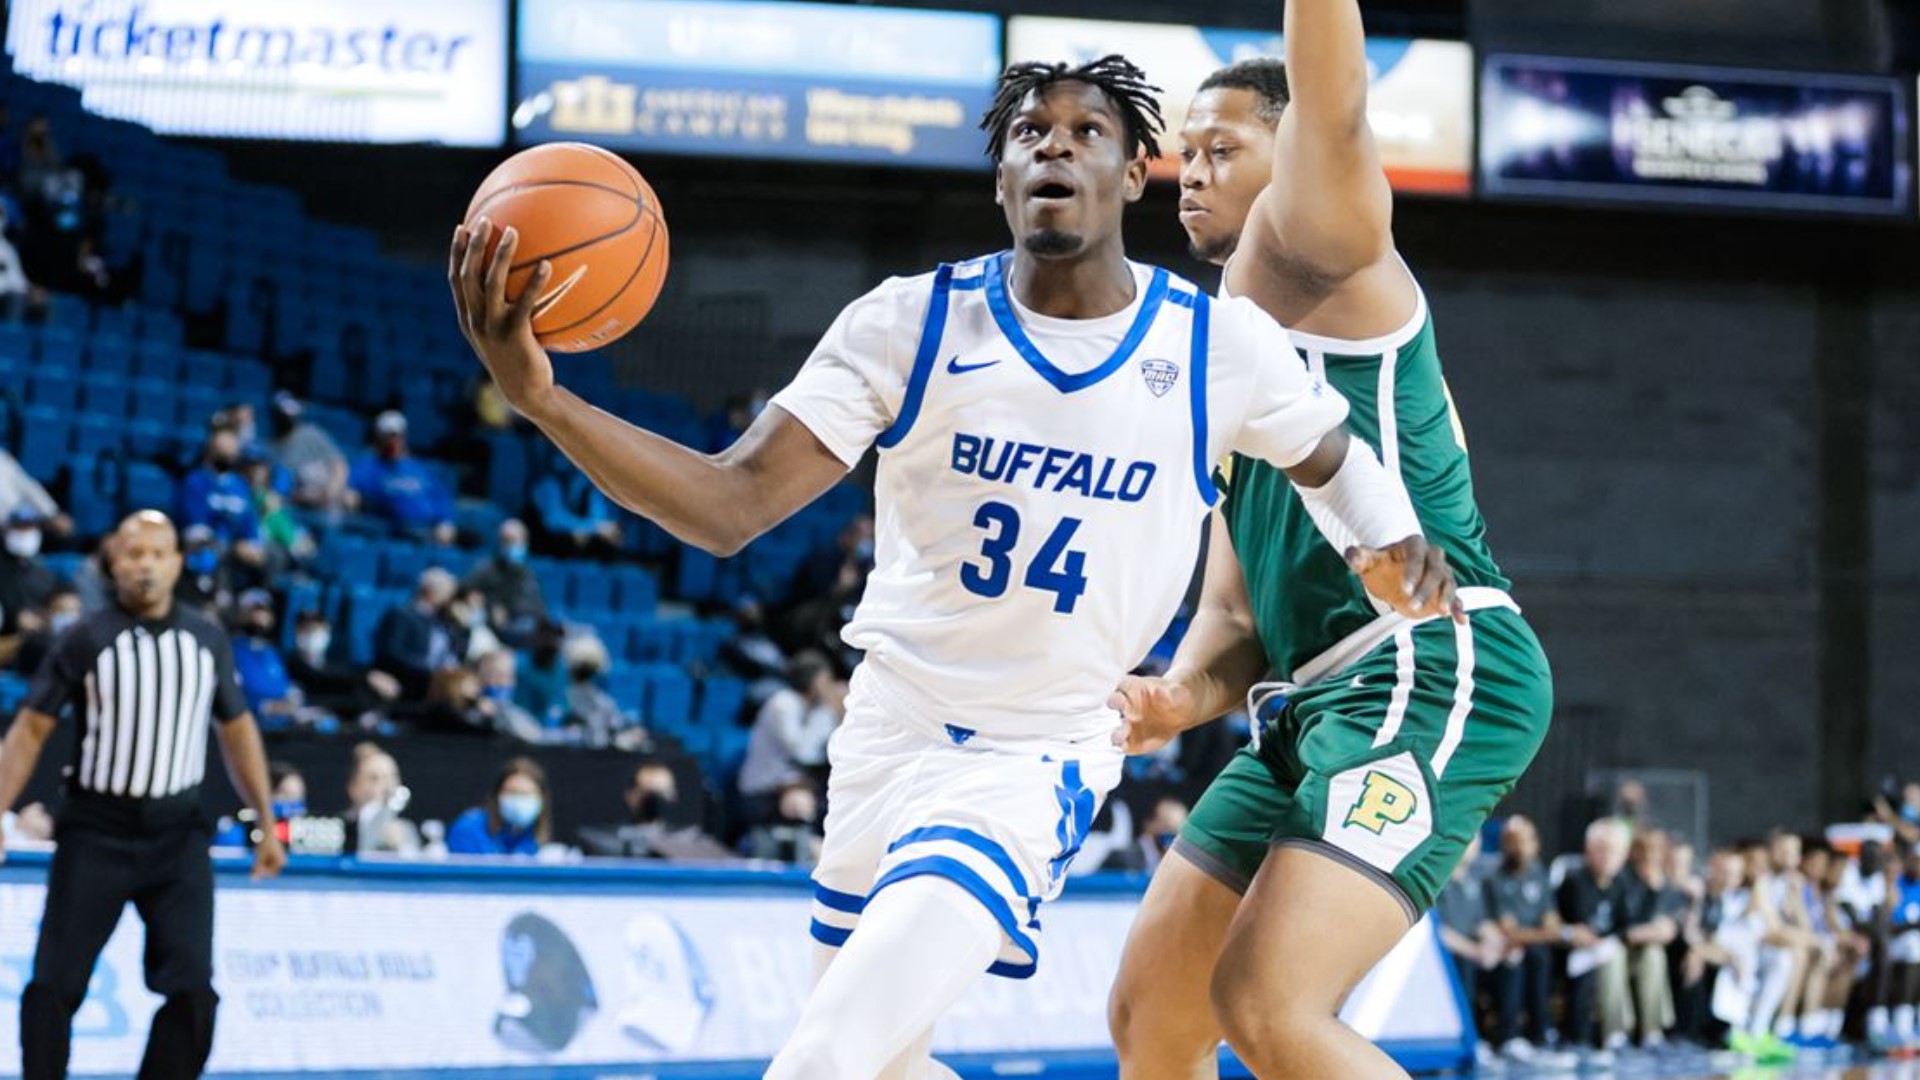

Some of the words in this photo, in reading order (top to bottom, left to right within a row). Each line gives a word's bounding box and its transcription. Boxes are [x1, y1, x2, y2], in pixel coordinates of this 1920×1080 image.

[46, 2, 472, 73] ticketmaster
[951, 432, 1157, 503] BUFFALO
[959, 501, 1088, 614] 34
[1342, 769, 1418, 836] P
